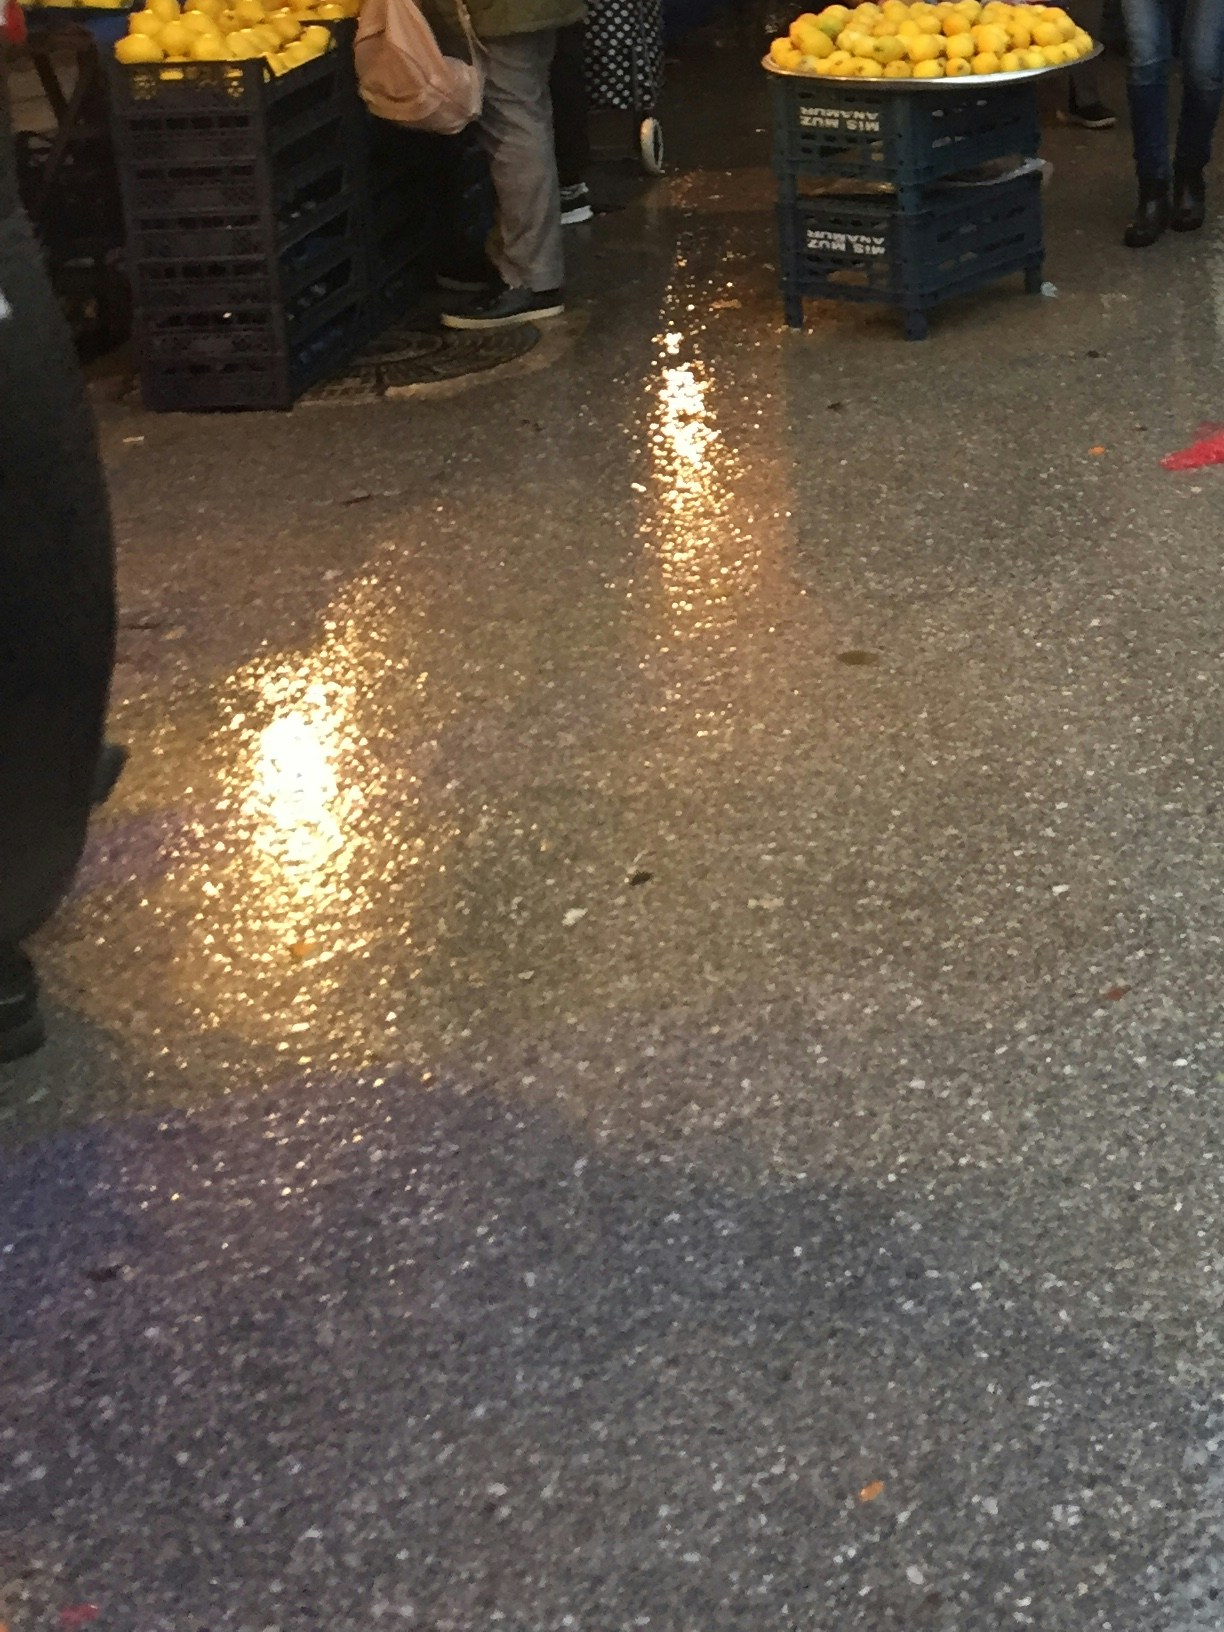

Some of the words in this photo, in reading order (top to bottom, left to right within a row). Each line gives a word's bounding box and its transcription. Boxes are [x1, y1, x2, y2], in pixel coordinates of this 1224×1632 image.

[801, 107, 878, 119] ANAMUR
[801, 116, 839, 128] MUZ
[807, 230, 884, 244] ANAMUR
[808, 240, 845, 251] MUZ
